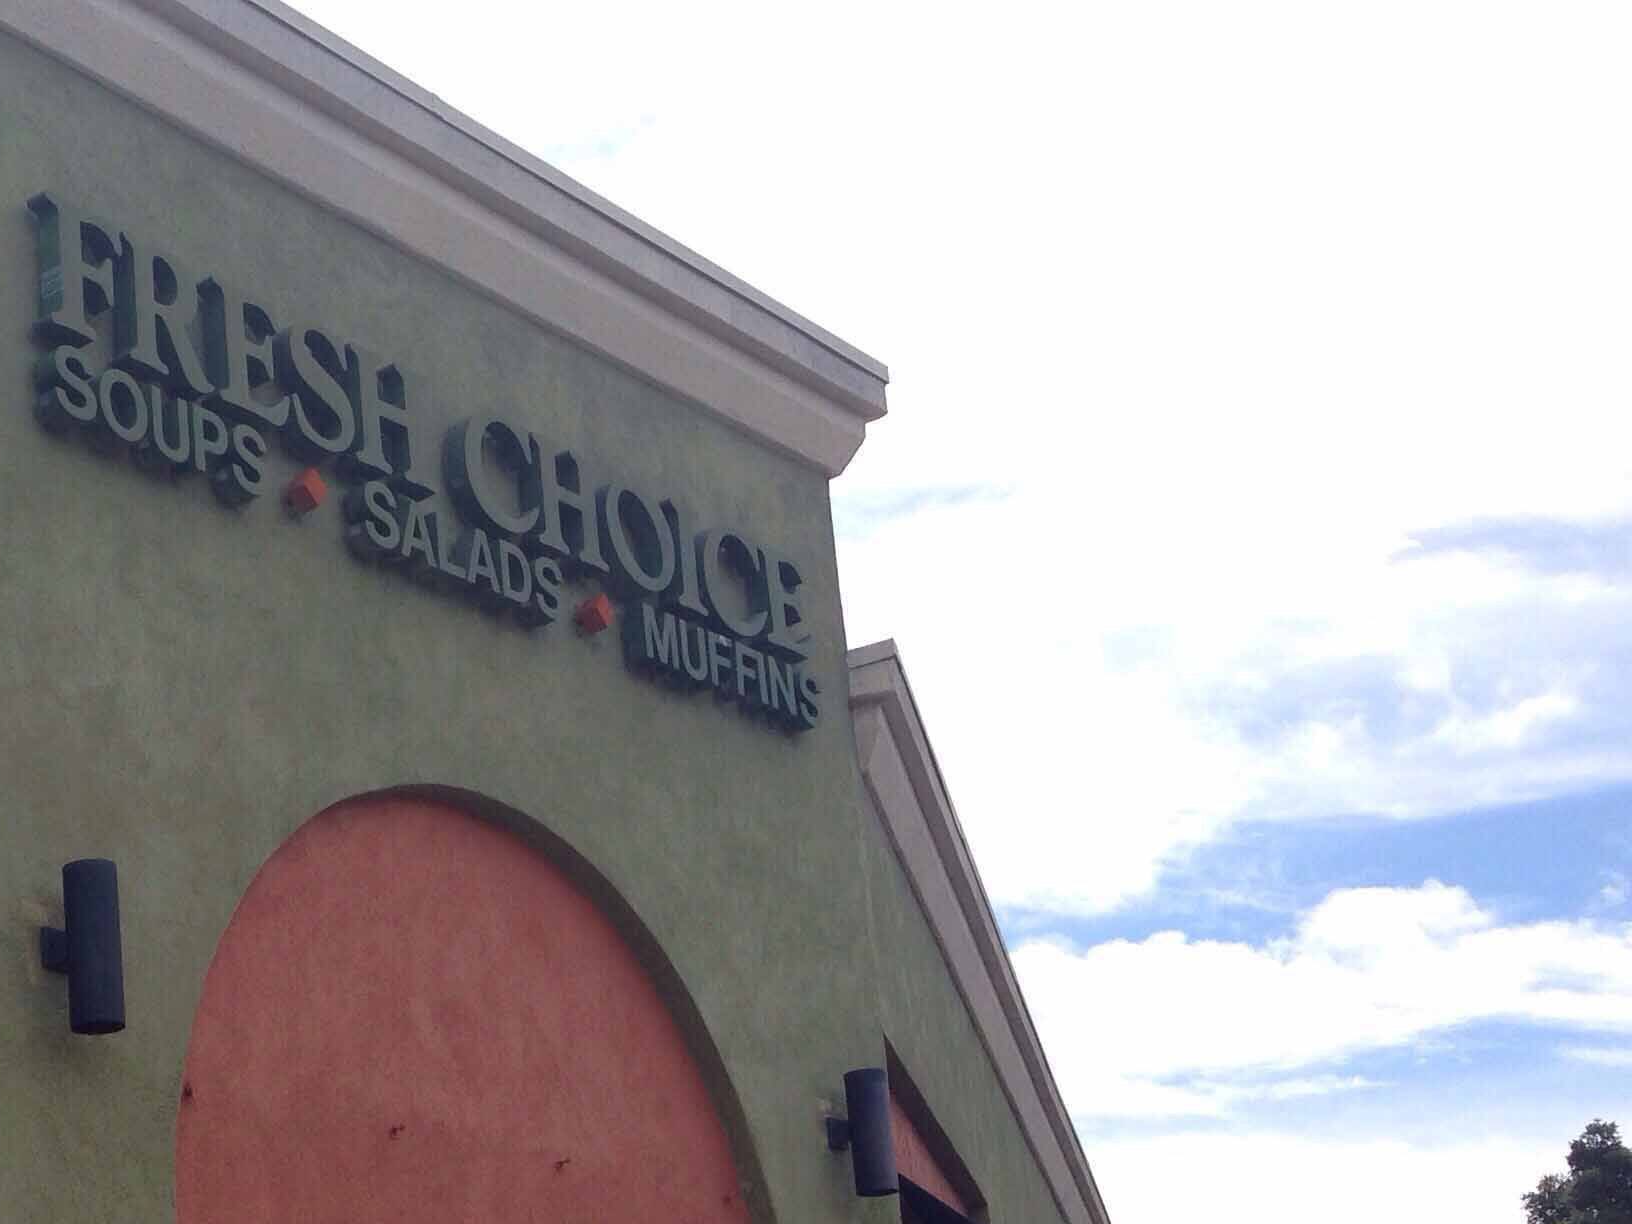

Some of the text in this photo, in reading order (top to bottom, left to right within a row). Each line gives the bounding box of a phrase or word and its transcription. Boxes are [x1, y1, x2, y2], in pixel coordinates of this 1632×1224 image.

[27, 192, 814, 660] FRESH CHOICE
[36, 344, 821, 730] SOUPS SALADS MUFFINS
